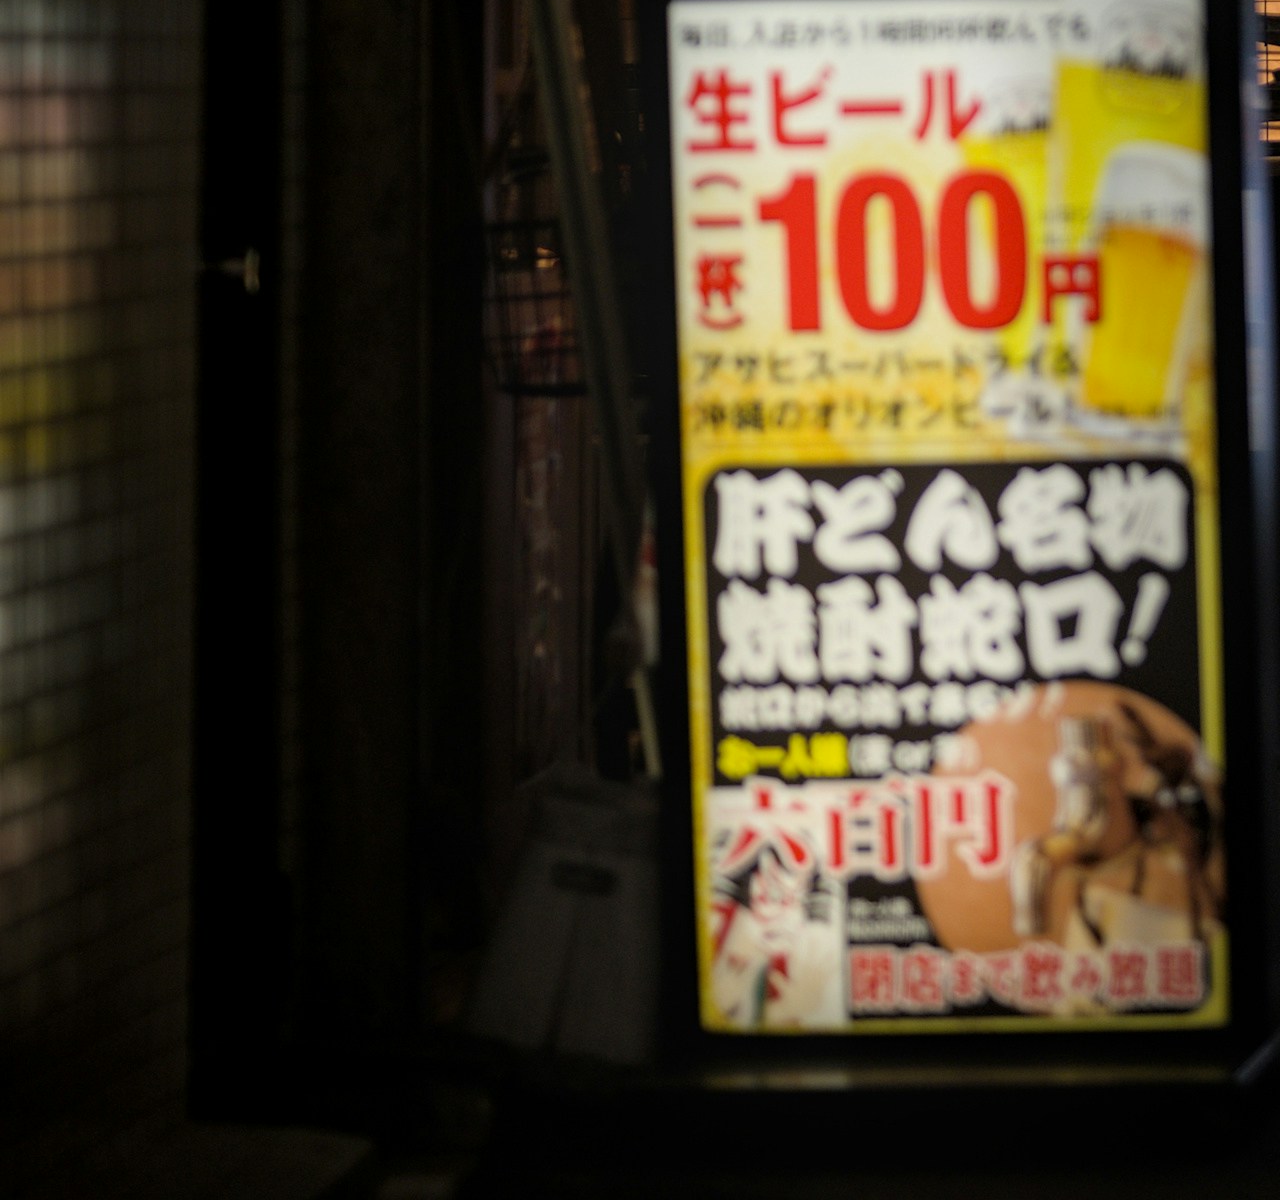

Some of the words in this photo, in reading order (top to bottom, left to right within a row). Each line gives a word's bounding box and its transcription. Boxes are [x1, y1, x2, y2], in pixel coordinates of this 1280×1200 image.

[684, 61, 988, 157] 生ビール
[713, 465, 1188, 574] 肝どん名物
[717, 781, 1011, 874] 六百円
